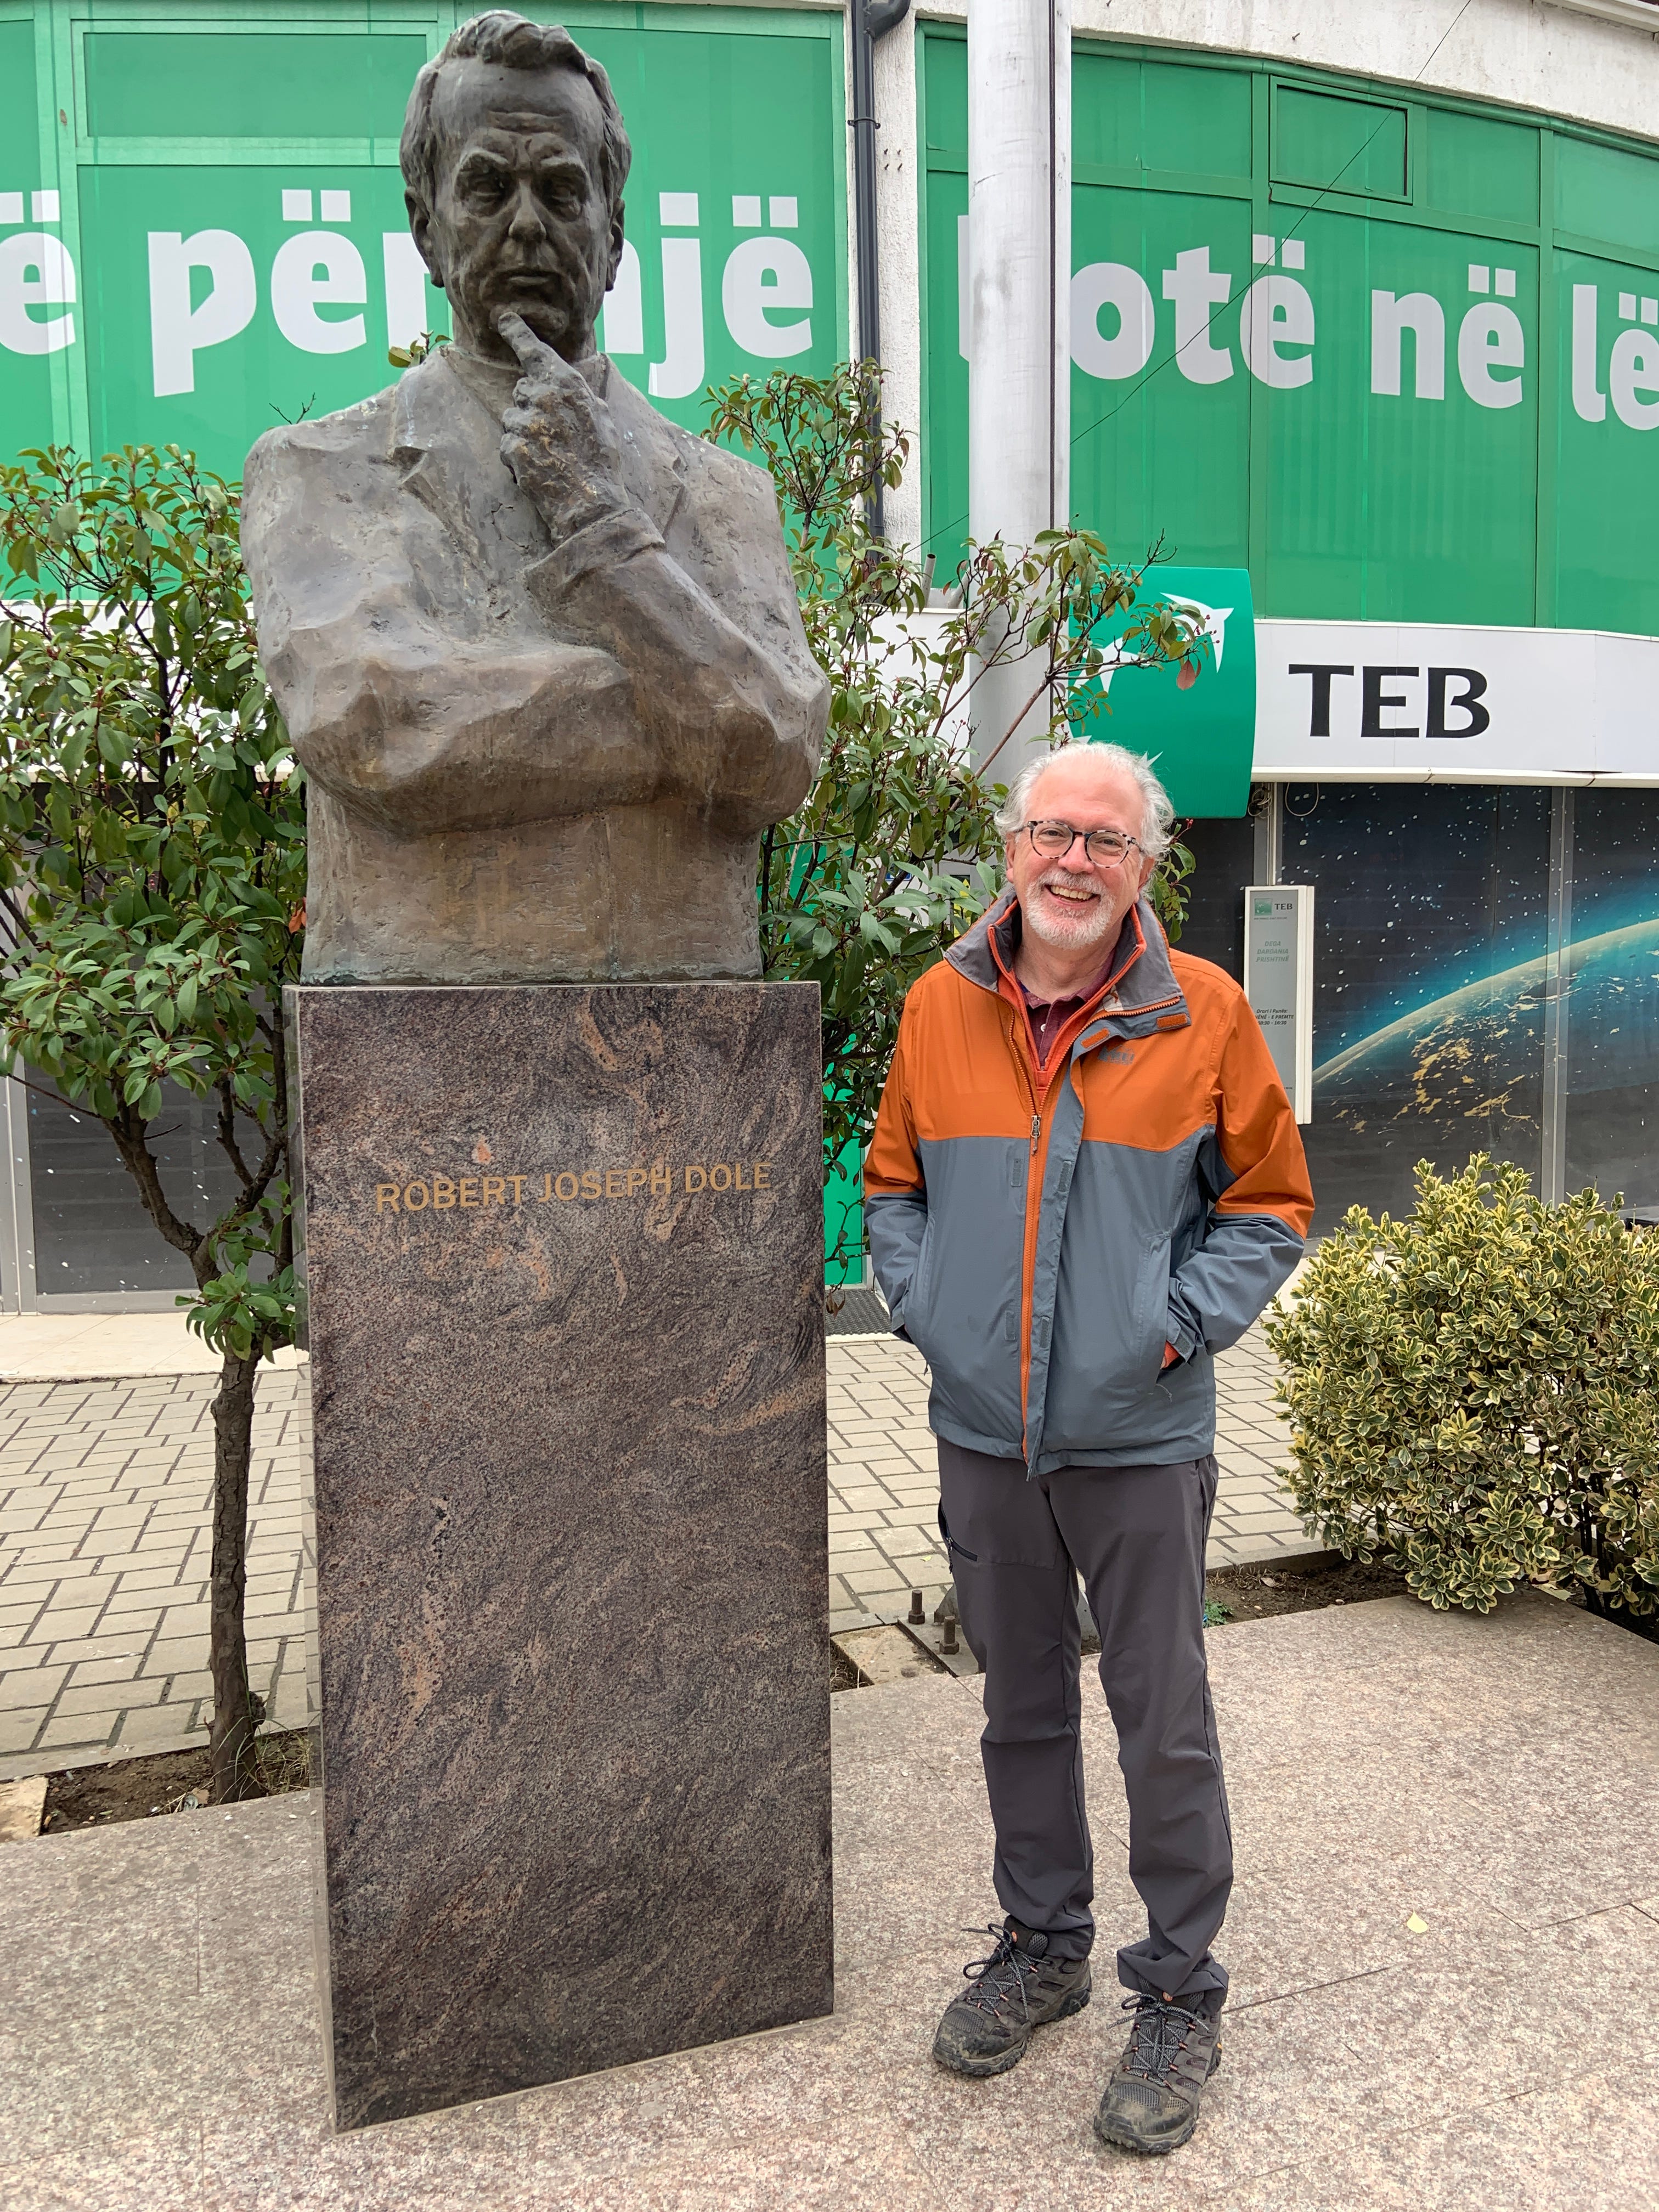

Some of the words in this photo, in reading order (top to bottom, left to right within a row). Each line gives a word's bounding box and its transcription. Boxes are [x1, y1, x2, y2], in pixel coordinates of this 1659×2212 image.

[958, 215, 1315, 389] otë
[1370, 263, 1525, 409] në
[1572, 283, 1659, 431] lë
[1288, 664, 1491, 739] TEB
[375, 1174, 528, 1214] ROBERT
[537, 1167, 672, 1203] JOSEPH
[684, 1162, 772, 1194] DOLE
